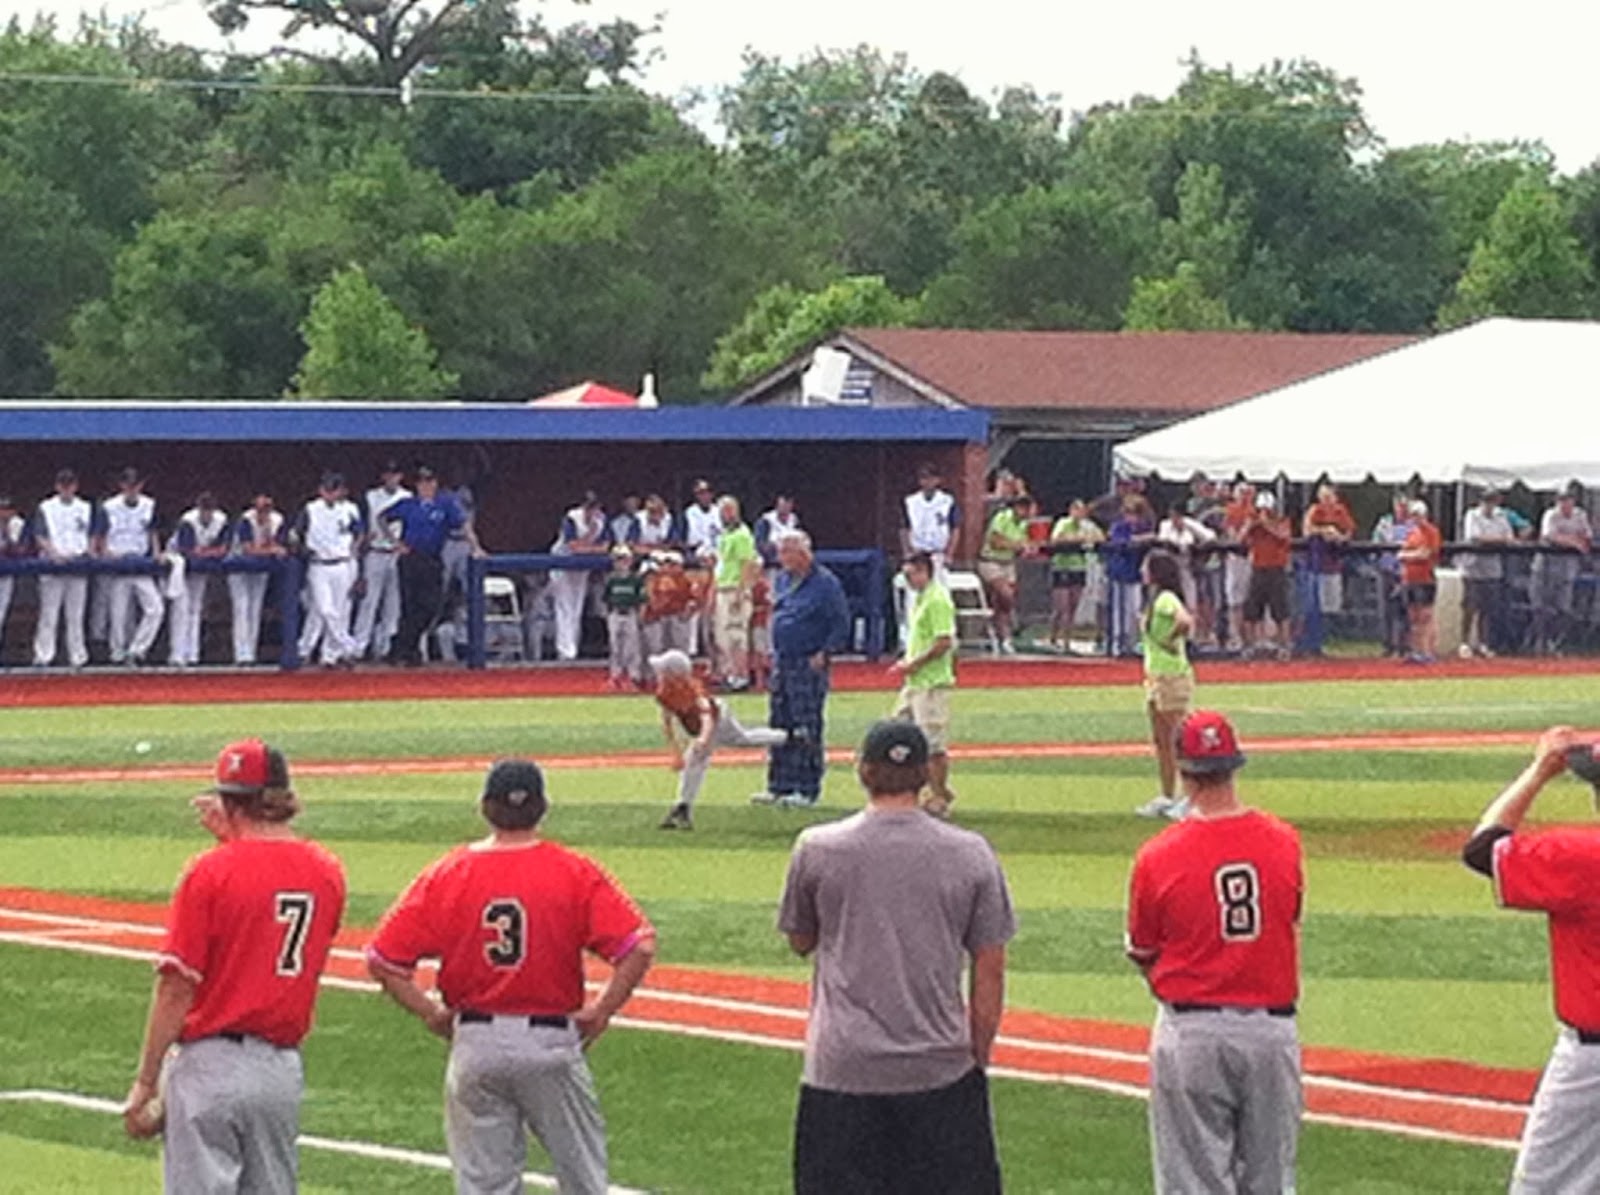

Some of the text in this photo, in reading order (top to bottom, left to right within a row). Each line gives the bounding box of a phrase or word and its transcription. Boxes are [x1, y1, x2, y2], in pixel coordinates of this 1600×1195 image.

[274, 892, 315, 977] 7
[482, 897, 527, 970] 3
[1215, 862, 1261, 942] 8
